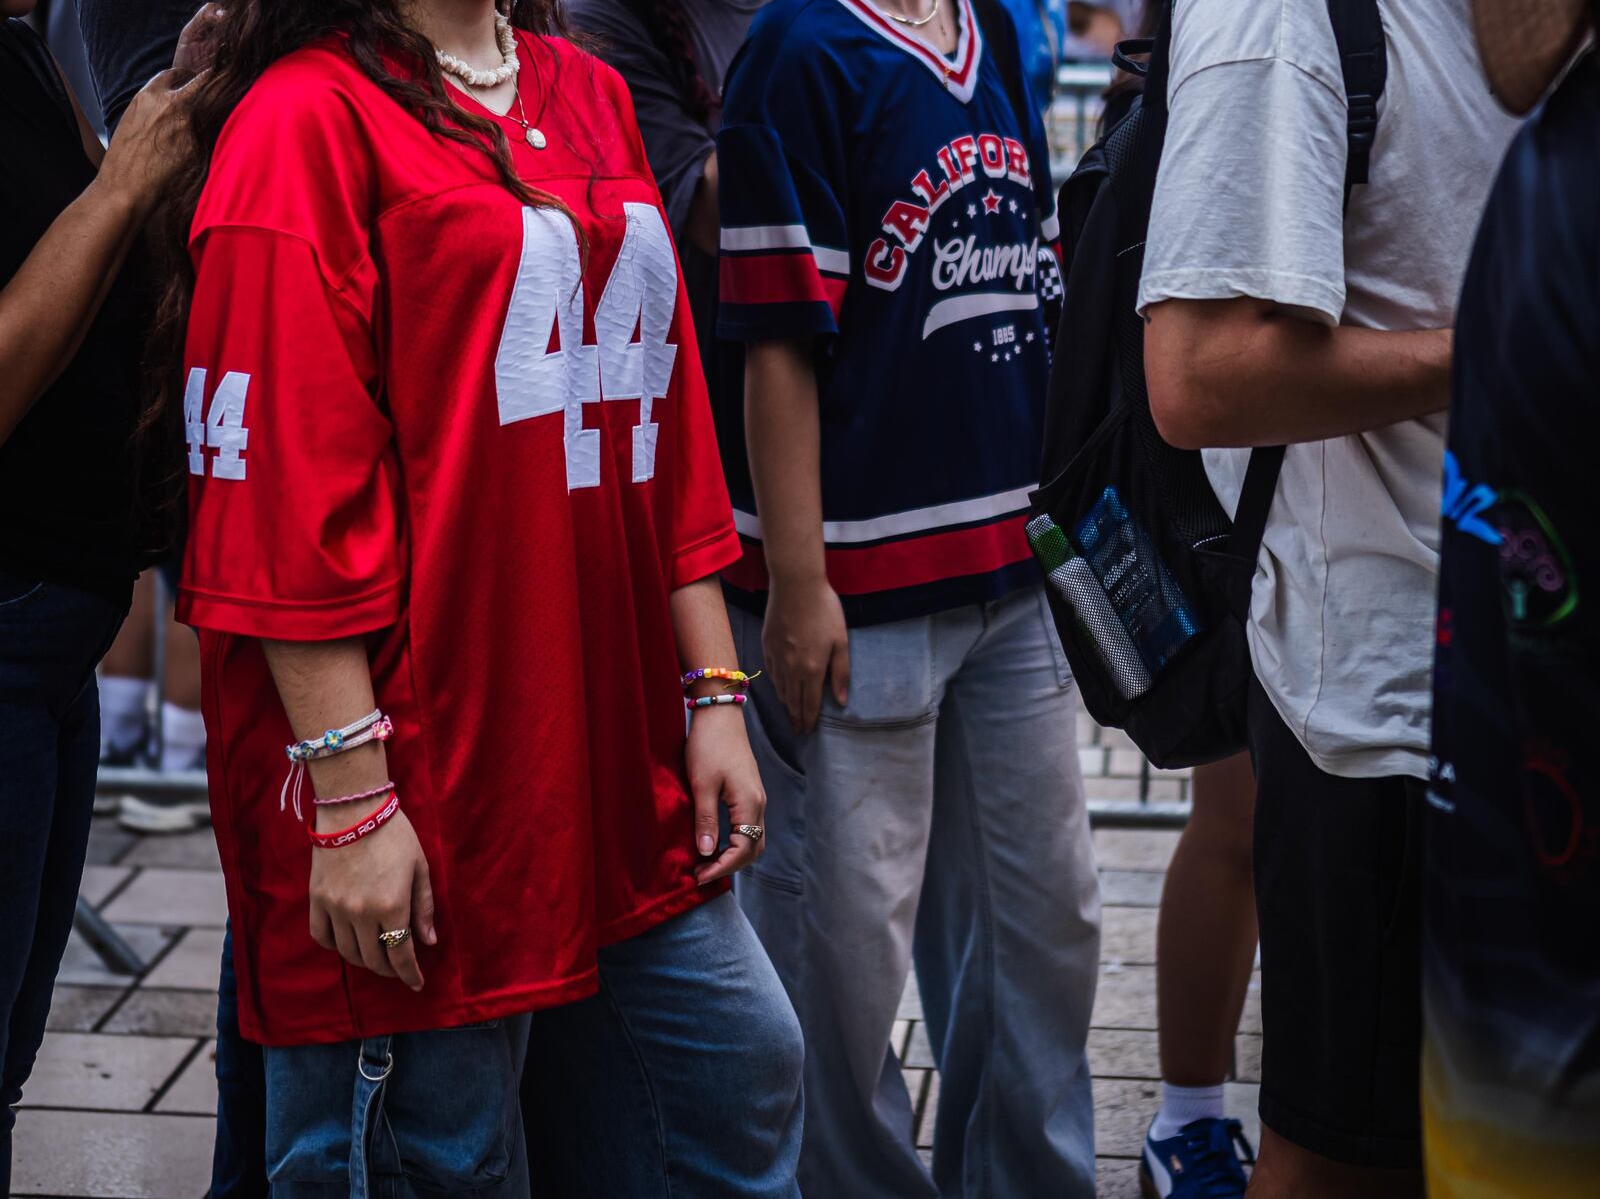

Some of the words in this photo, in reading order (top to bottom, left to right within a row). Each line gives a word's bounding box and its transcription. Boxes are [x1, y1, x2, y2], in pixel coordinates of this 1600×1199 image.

[864, 133, 1034, 292] CALIFOR
[495, 202, 678, 495] 44
[183, 366, 251, 481] 44
[331, 832, 357, 847] UPR
